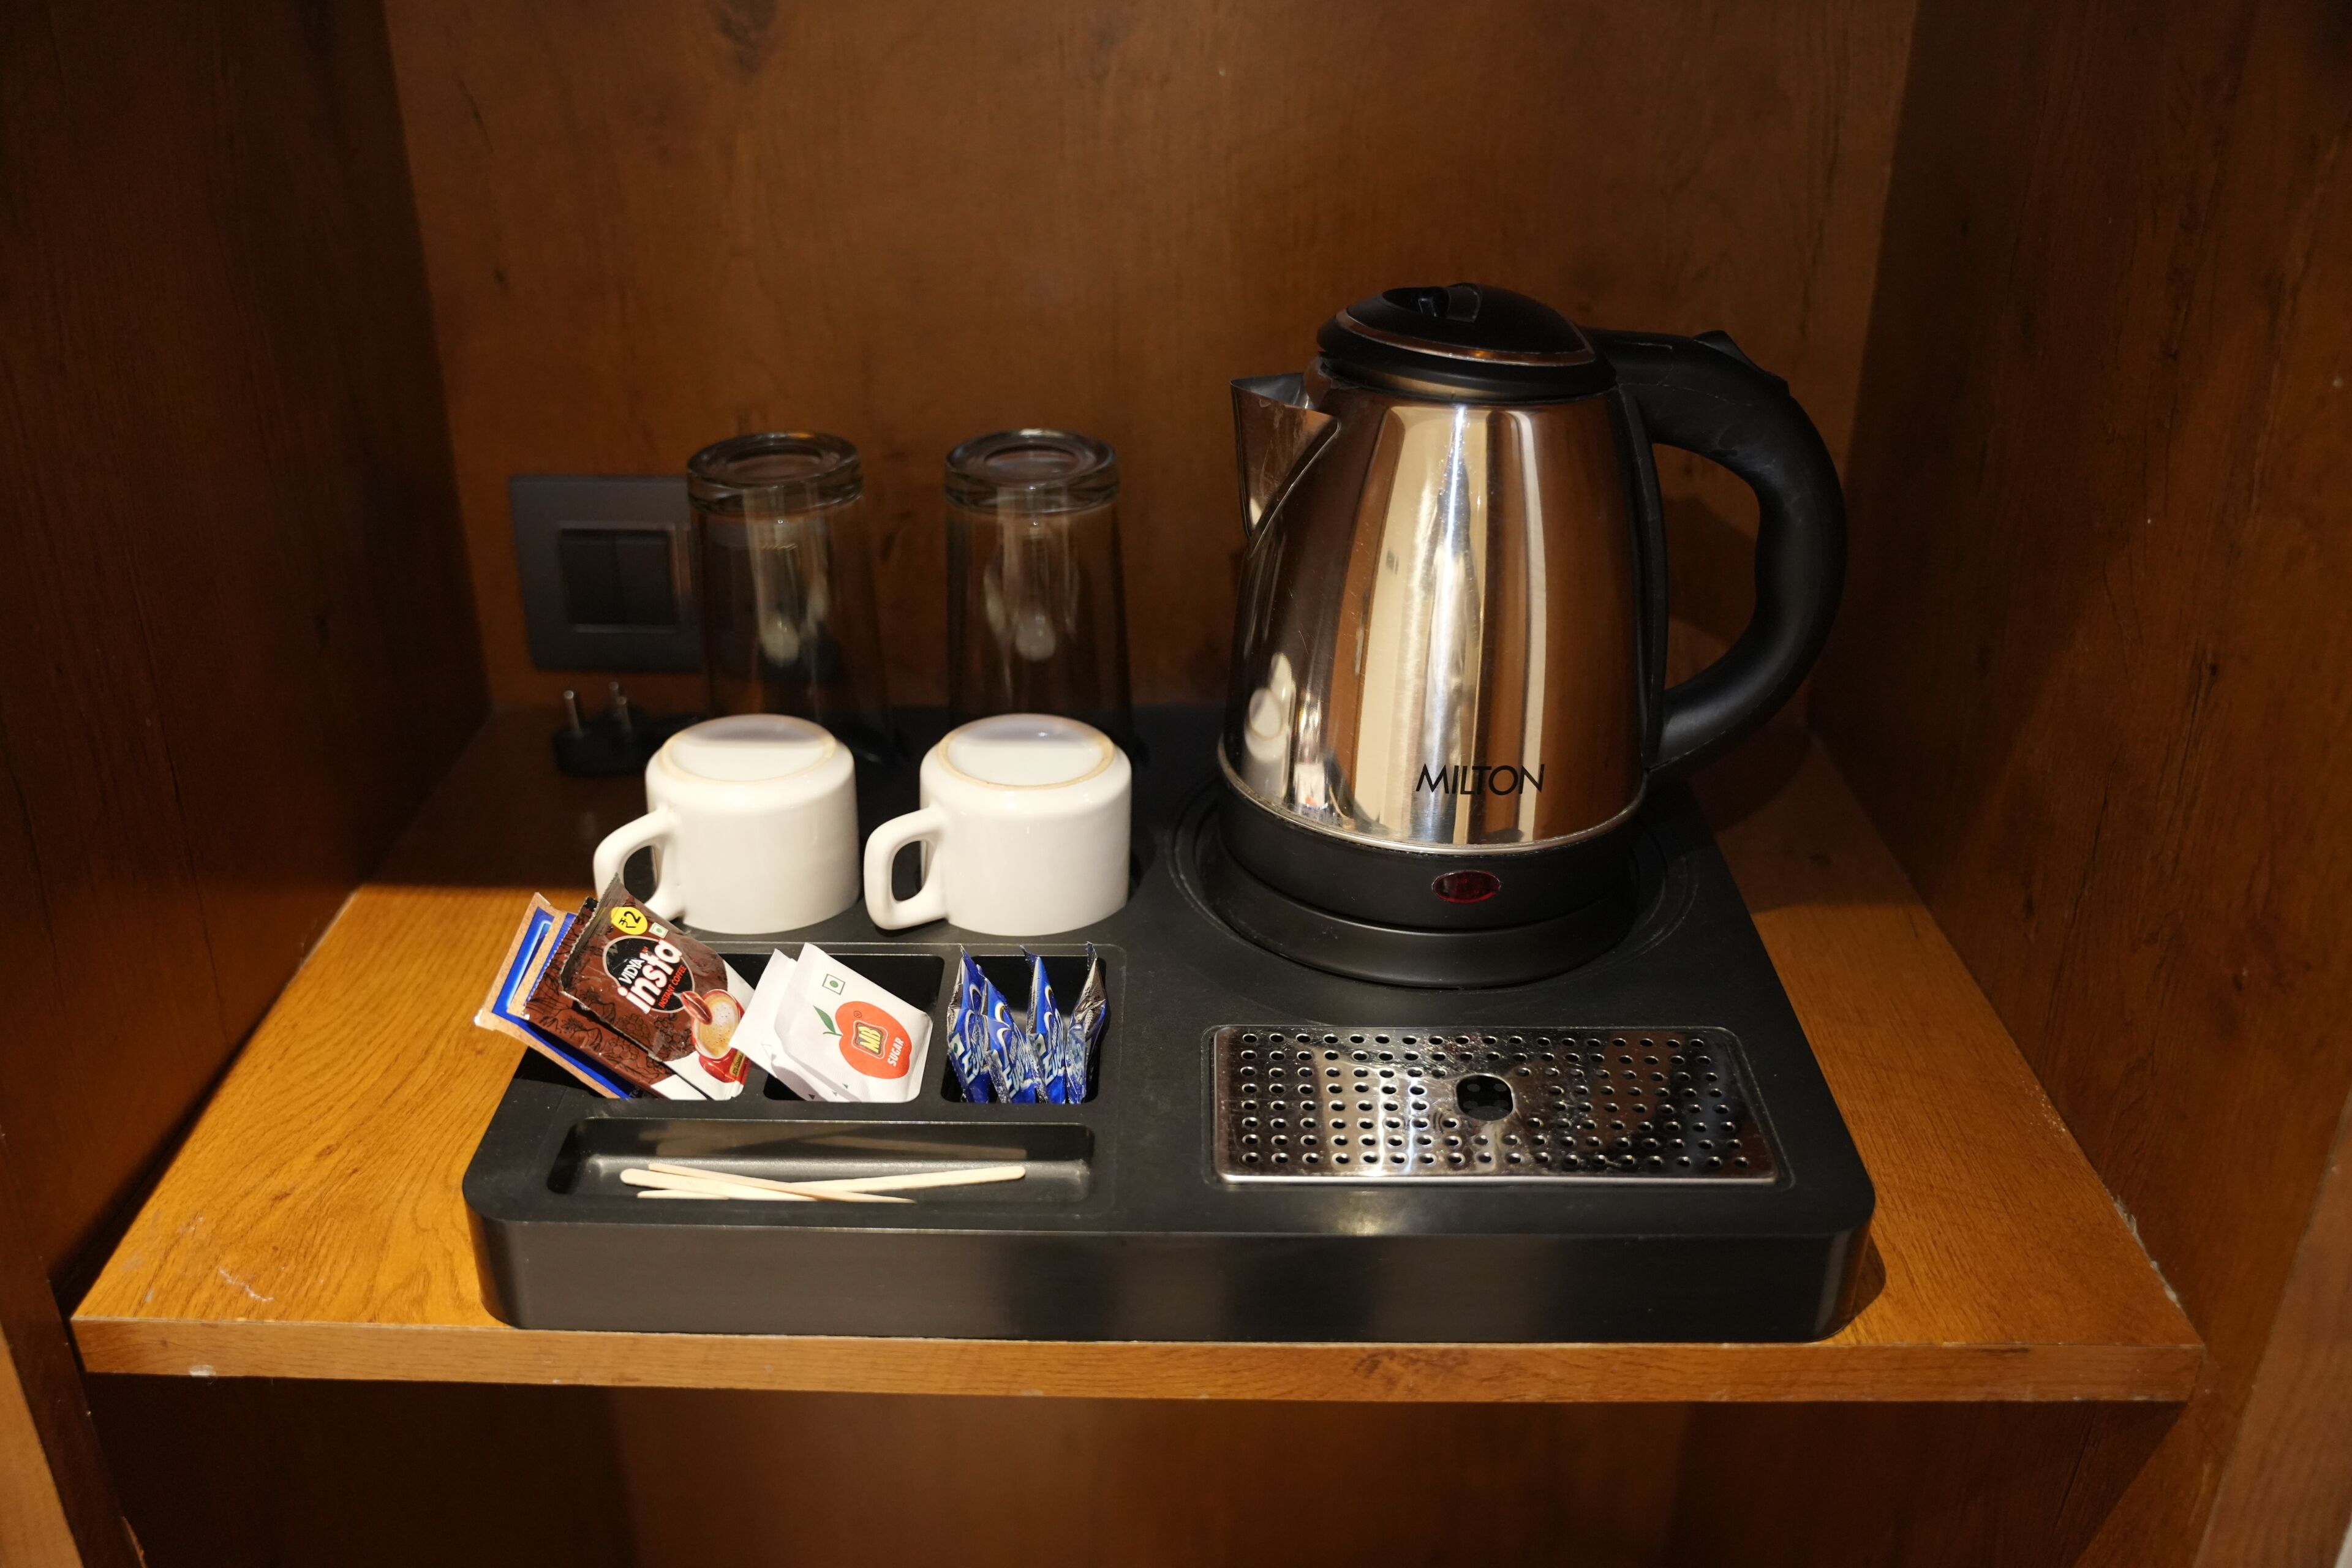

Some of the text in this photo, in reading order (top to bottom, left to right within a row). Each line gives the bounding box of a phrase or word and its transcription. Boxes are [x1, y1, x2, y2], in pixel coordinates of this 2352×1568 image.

[1416, 763, 1545, 796] MILTON
[619, 911, 641, 929] ₹2
[617, 939, 683, 1015] insta
[618, 957, 646, 984] VIDYA
[658, 964, 687, 1009] INSTANT COFFEE
[857, 1026, 881, 1054] MB
[887, 1037, 904, 1067] SUGAR
